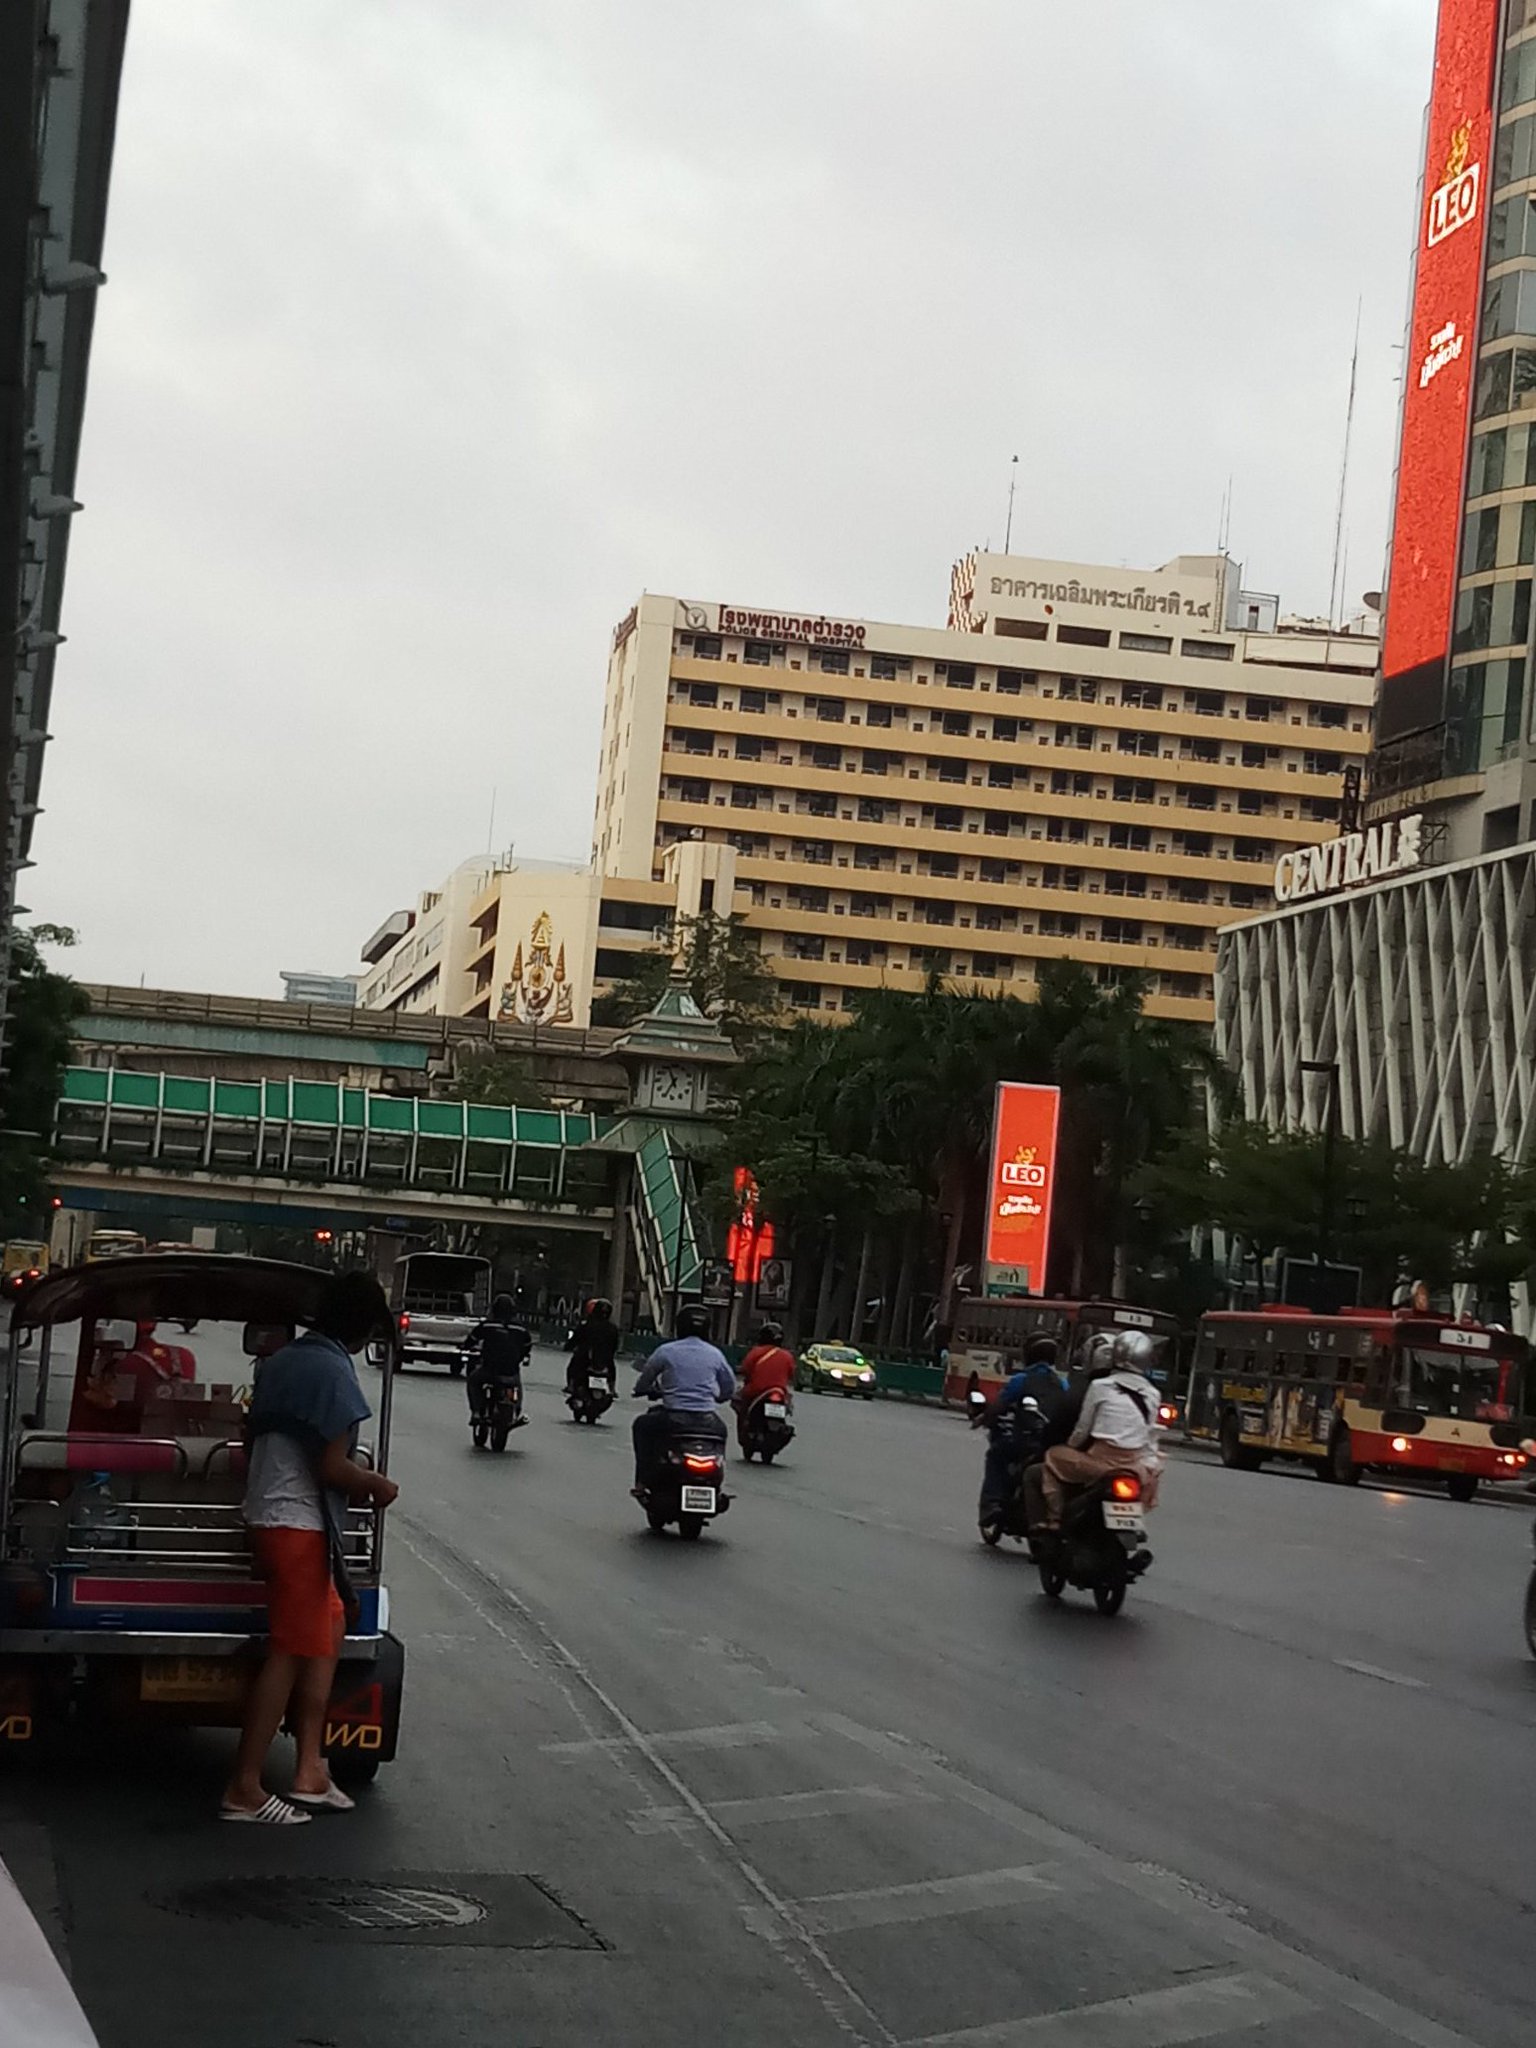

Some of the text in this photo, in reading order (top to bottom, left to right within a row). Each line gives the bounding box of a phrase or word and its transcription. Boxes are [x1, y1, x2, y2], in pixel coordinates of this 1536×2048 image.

[1431, 173, 1475, 237] LEO
[990, 576, 1181, 616] อาคารเฉลิมพระเกียรติ
[719, 604, 866, 640] โรงพยาบาลตำรวจ
[719, 624, 866, 649] POLICE GENERAL HOSPITAL
[1275, 822, 1399, 901] CENTRAL
[1006, 1166, 1042, 1184] LEO
